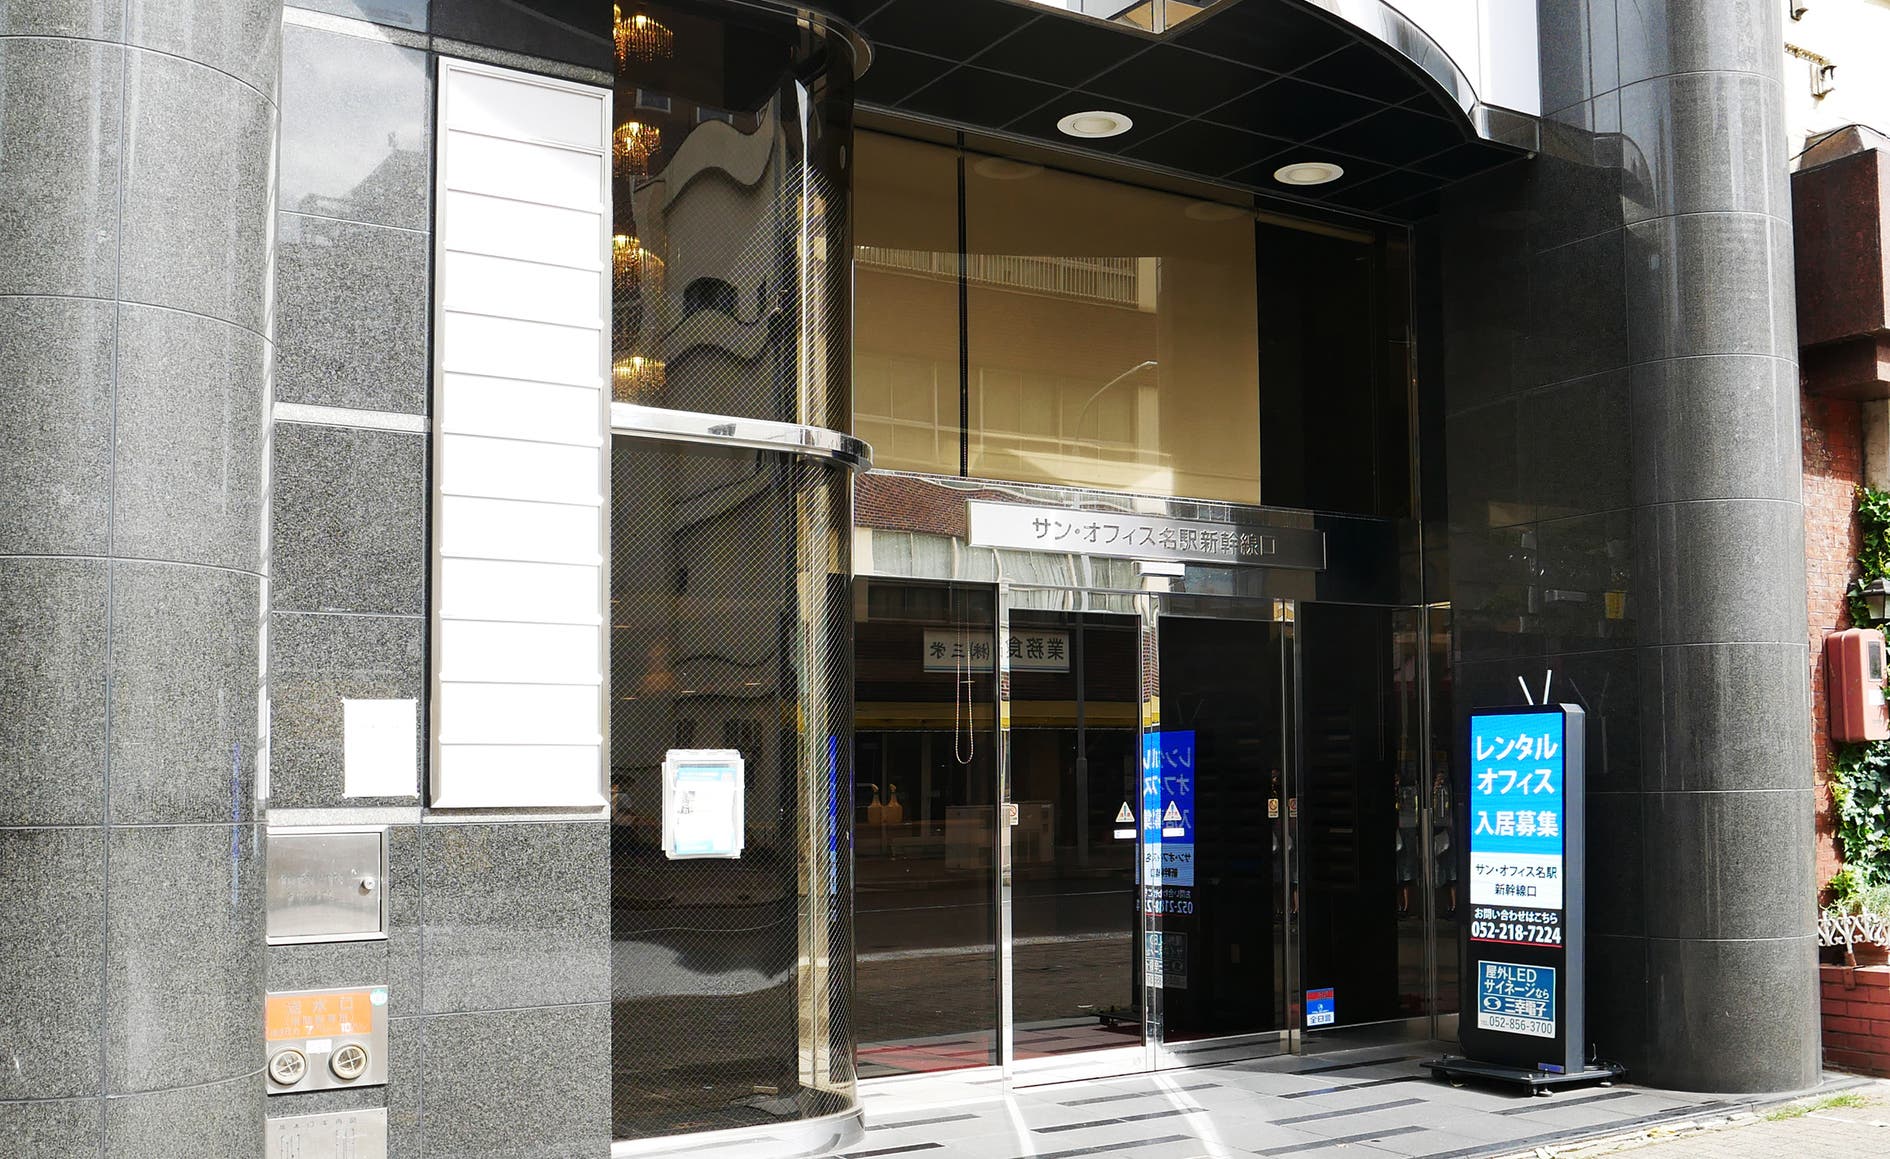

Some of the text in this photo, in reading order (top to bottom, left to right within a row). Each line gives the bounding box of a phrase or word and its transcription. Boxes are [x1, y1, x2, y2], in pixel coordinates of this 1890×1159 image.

[1032, 517, 1276, 556] サン・オフィス名駅新幹線口
[1476, 733, 1559, 762] レンタル
[1476, 767, 1556, 796] オフィス
[1474, 810, 1559, 838] 入居募集
[1475, 863, 1558, 880] サン・オフィス名駅
[1494, 883, 1537, 898] 新幹線口
[1474, 907, 1559, 925] お問い合わせはこちら
[1471, 921, 1562, 945] 052-218-7224
[1485, 965, 1537, 983] 屋外LED
[1483, 979, 1550, 1000] サイネージなら
[1489, 1015, 1553, 1035] 052-856-3700
